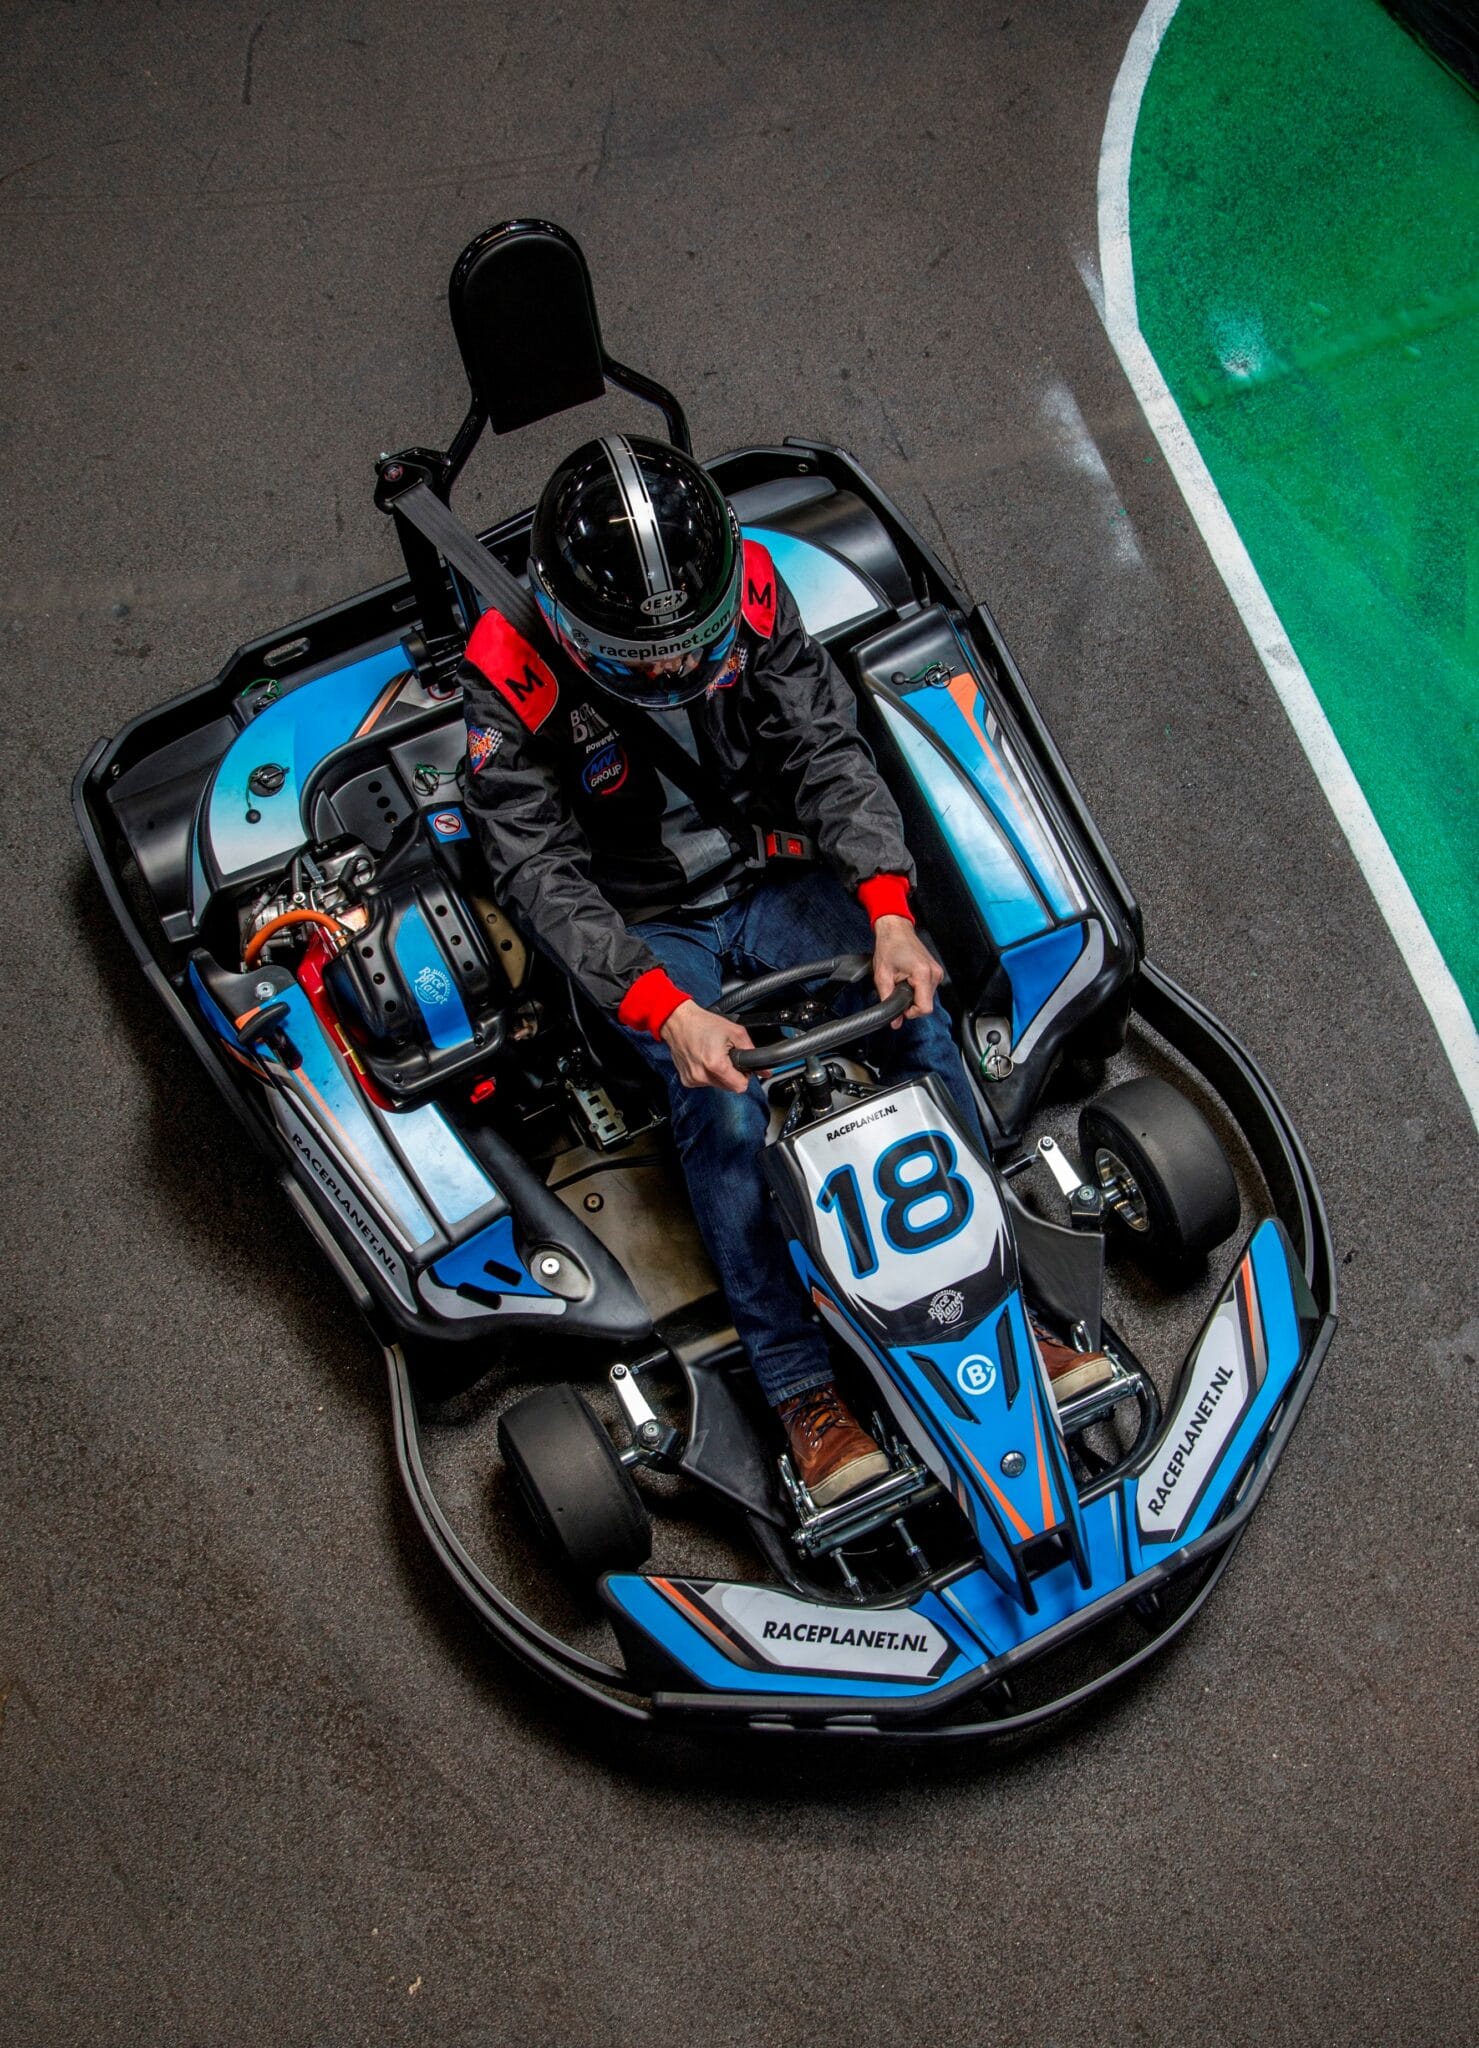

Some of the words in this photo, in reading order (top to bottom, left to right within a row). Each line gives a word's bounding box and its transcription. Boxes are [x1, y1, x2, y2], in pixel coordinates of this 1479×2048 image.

[748, 578, 772, 610] M
[600, 609, 732, 660] raceplanet.com
[505, 664, 545, 704] M
[590, 764, 622, 787] GROUP
[414, 974, 448, 1005] Planet
[418, 966, 445, 989] Race
[826, 1104, 899, 1142] RACEPLANET.NL
[292, 1133, 397, 1275] RACEPLANET.NL
[816, 1129, 974, 1280] 18
[927, 1295, 950, 1320] Race
[936, 1292, 965, 1325] Planet
[1148, 1366, 1234, 1517] RACEPLANET.NL
[762, 1621, 928, 1653] RACEPLANET.NL
